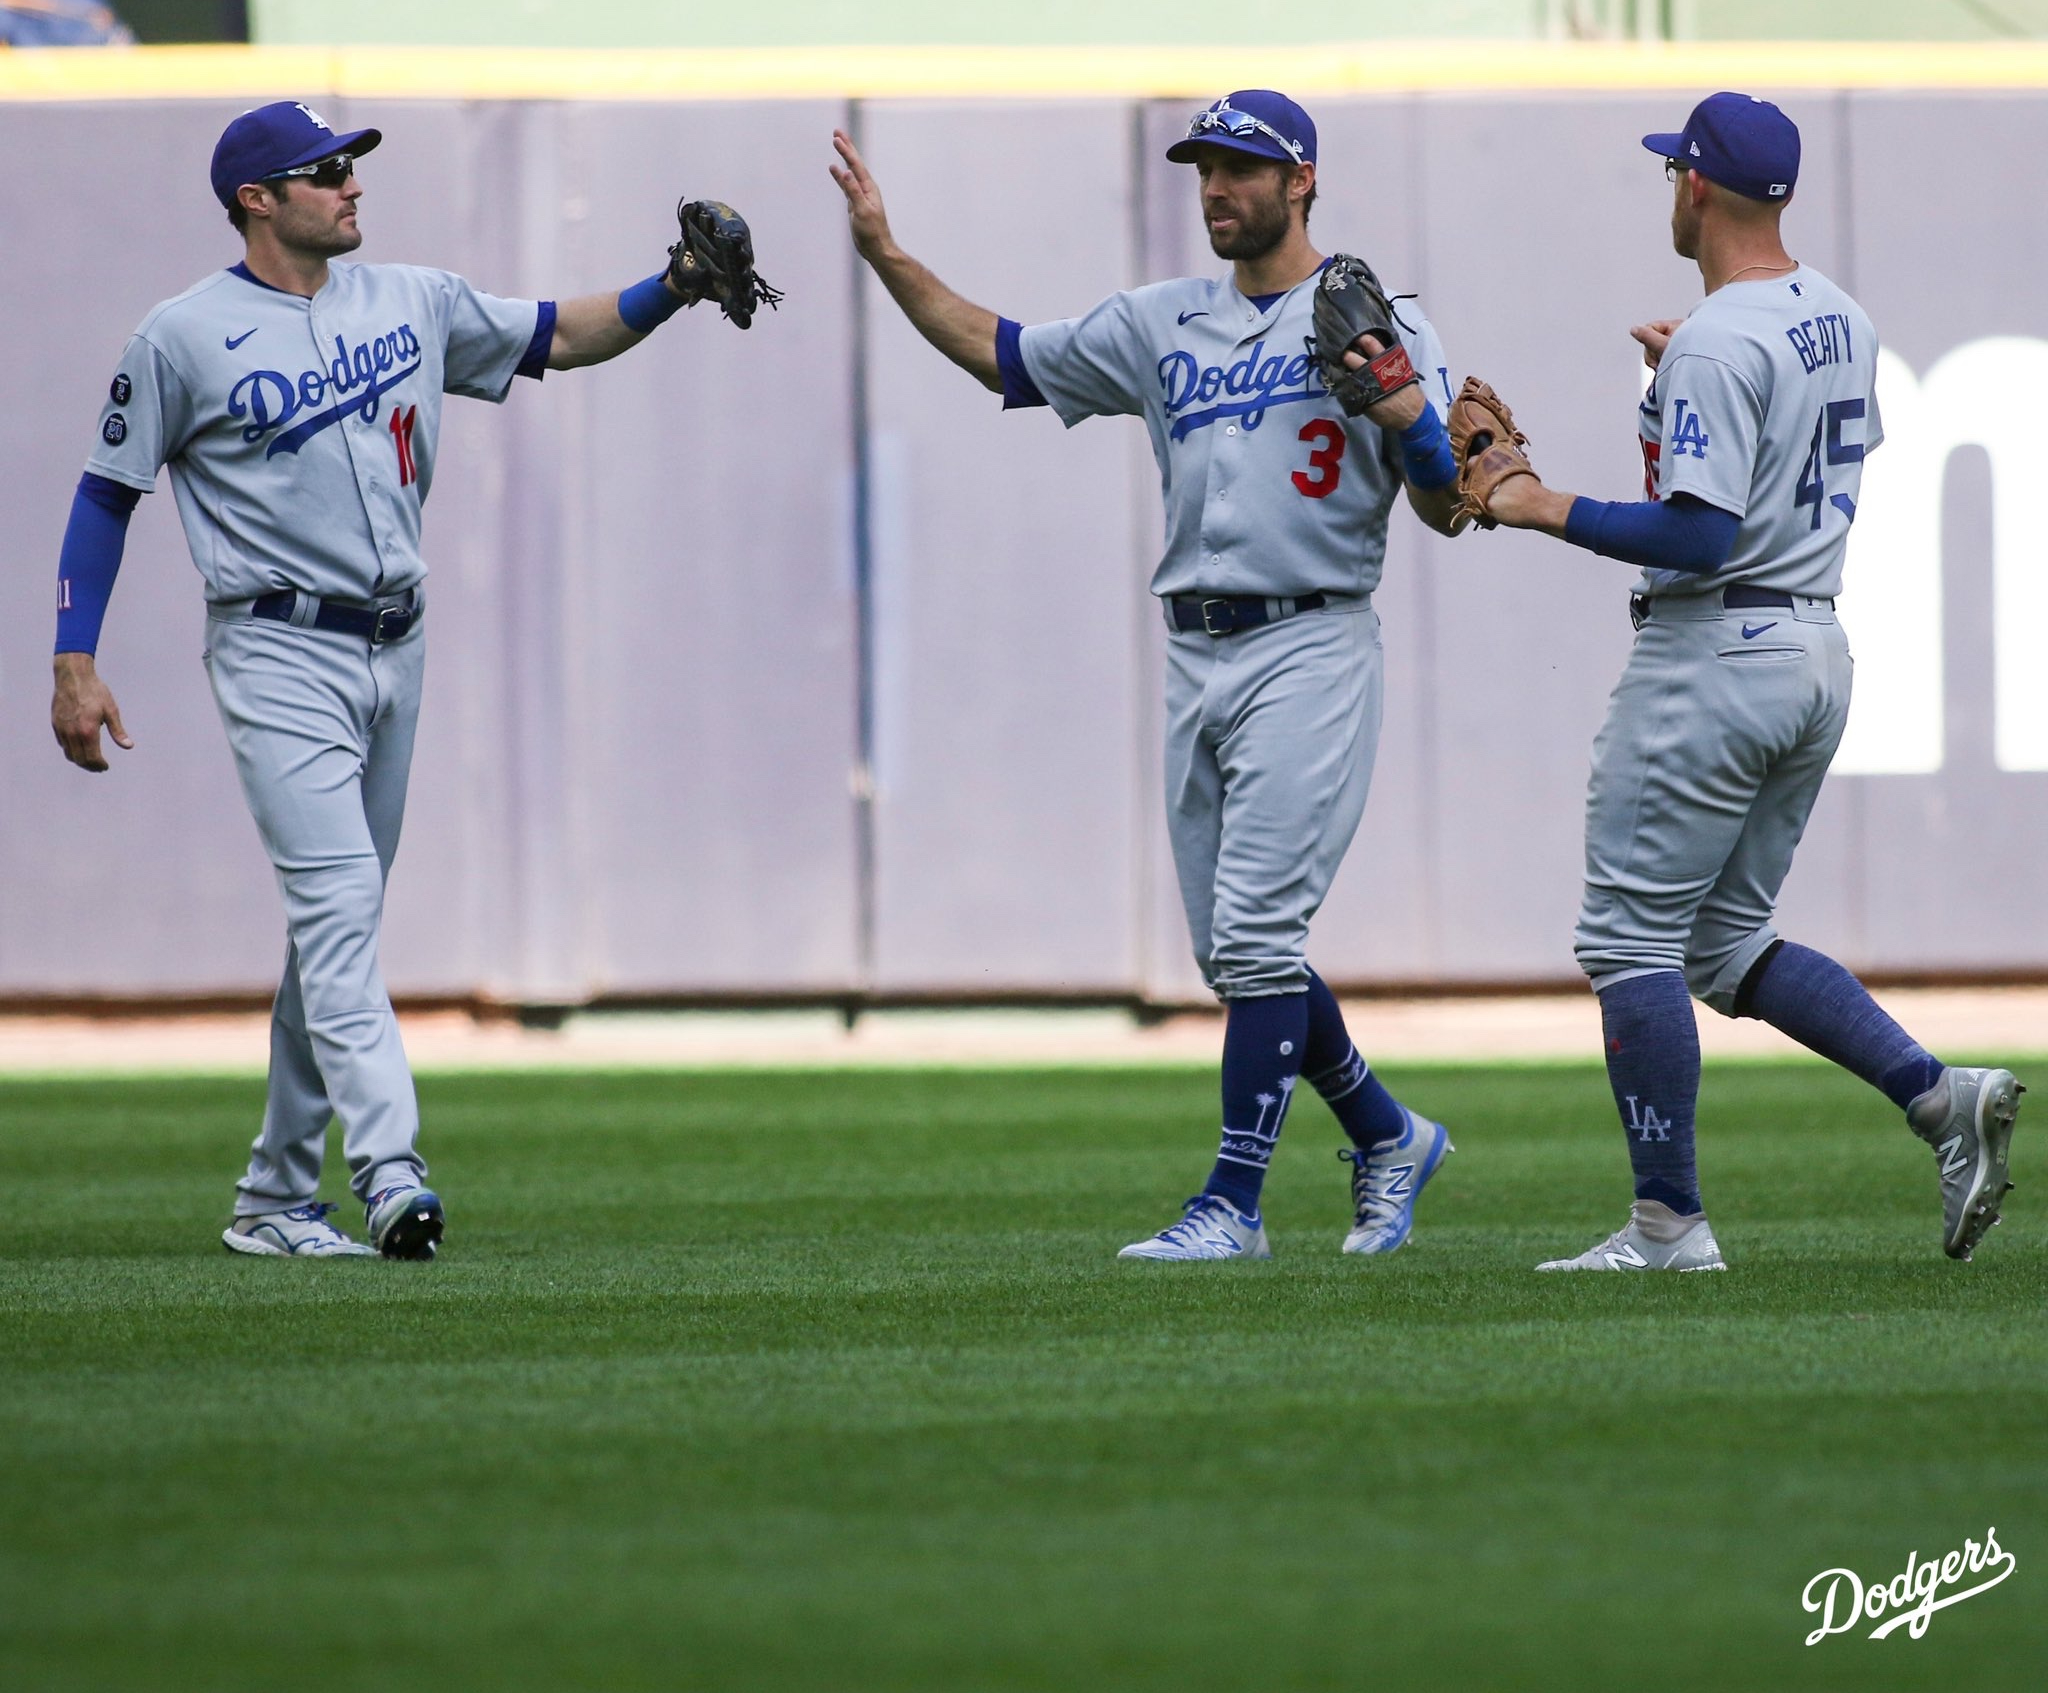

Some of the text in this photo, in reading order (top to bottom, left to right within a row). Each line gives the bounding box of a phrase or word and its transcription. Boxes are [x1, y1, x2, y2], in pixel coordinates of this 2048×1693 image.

[1785, 313, 1852, 374] BEATY
[105, 422, 123, 441] 20
[228, 323, 421, 461] Dodgers
[1158, 341, 1330, 444] Dodge
[1671, 399, 1708, 460] LA
[389, 404, 416, 487] 11
[1291, 418, 1346, 498] 3
[1794, 398, 1865, 530] 45
[1625, 1096, 1671, 1142] LA
